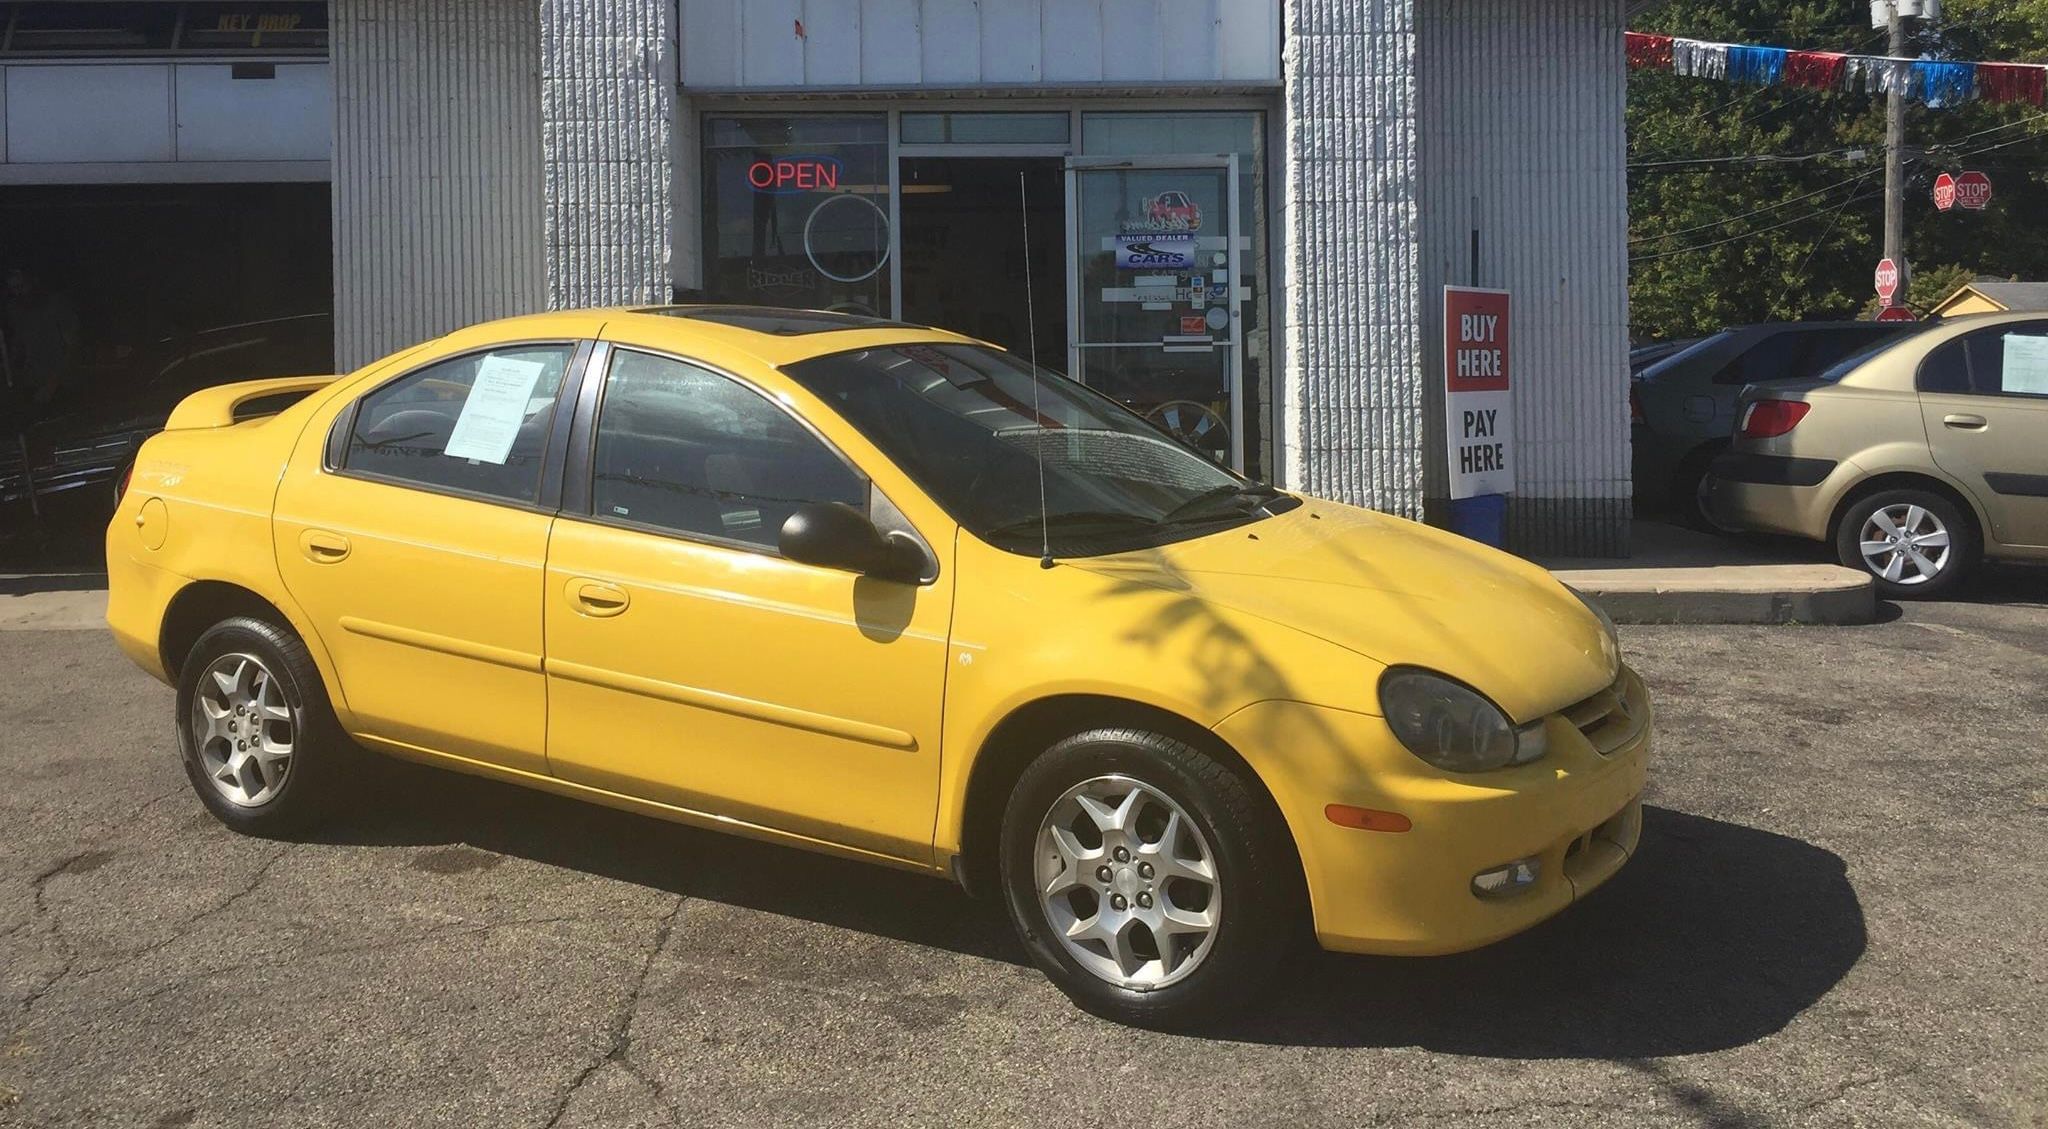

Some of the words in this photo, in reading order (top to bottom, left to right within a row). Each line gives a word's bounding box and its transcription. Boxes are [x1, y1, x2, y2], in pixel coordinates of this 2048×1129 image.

[218, 13, 250, 31] KEY
[257, 13, 302, 32] DROP
[748, 162, 837, 189] OPEN
[1935, 185, 1953, 201] STOP
[1956, 183, 1988, 197] STOP
[1155, 234, 1189, 242] DEALER
[1128, 252, 1184, 264] CARS
[1877, 270, 1896, 287] STOP
[1461, 314, 1498, 342] BUY
[1457, 349, 1502, 377] HERE
[1463, 409, 1497, 438] PAY
[1460, 443, 1504, 474] HERE
